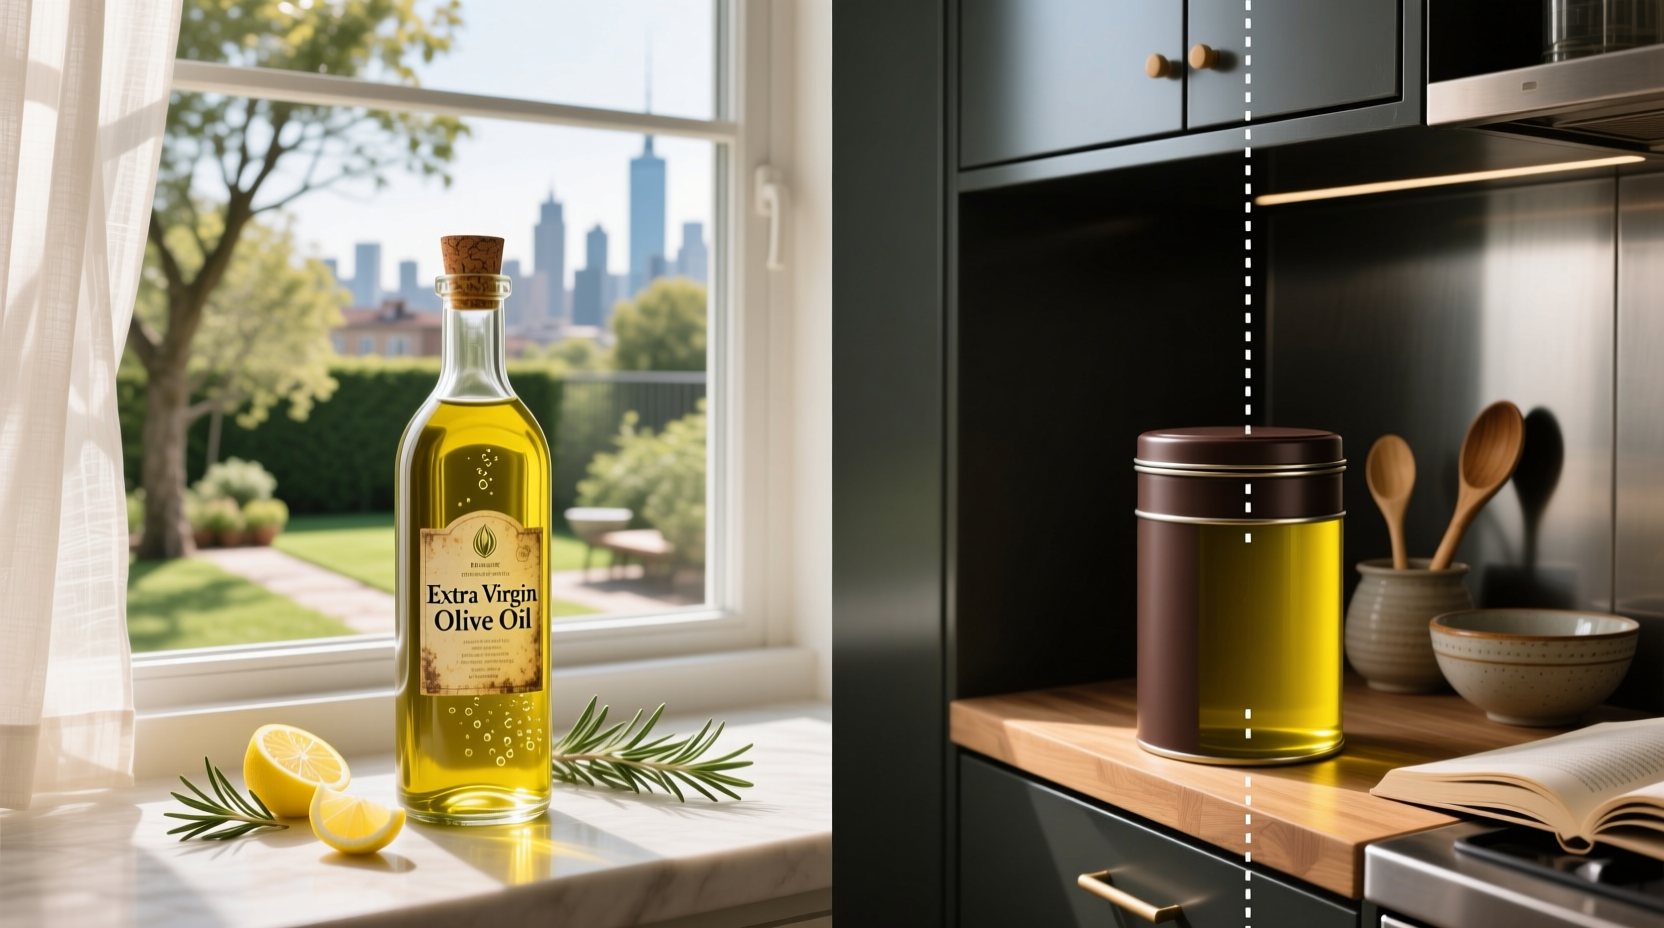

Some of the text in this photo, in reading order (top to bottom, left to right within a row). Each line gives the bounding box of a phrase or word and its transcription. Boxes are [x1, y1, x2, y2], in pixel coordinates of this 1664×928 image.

[427, 584, 537, 608] Extra Virgin
[434, 607, 532, 631] Olive Oil
